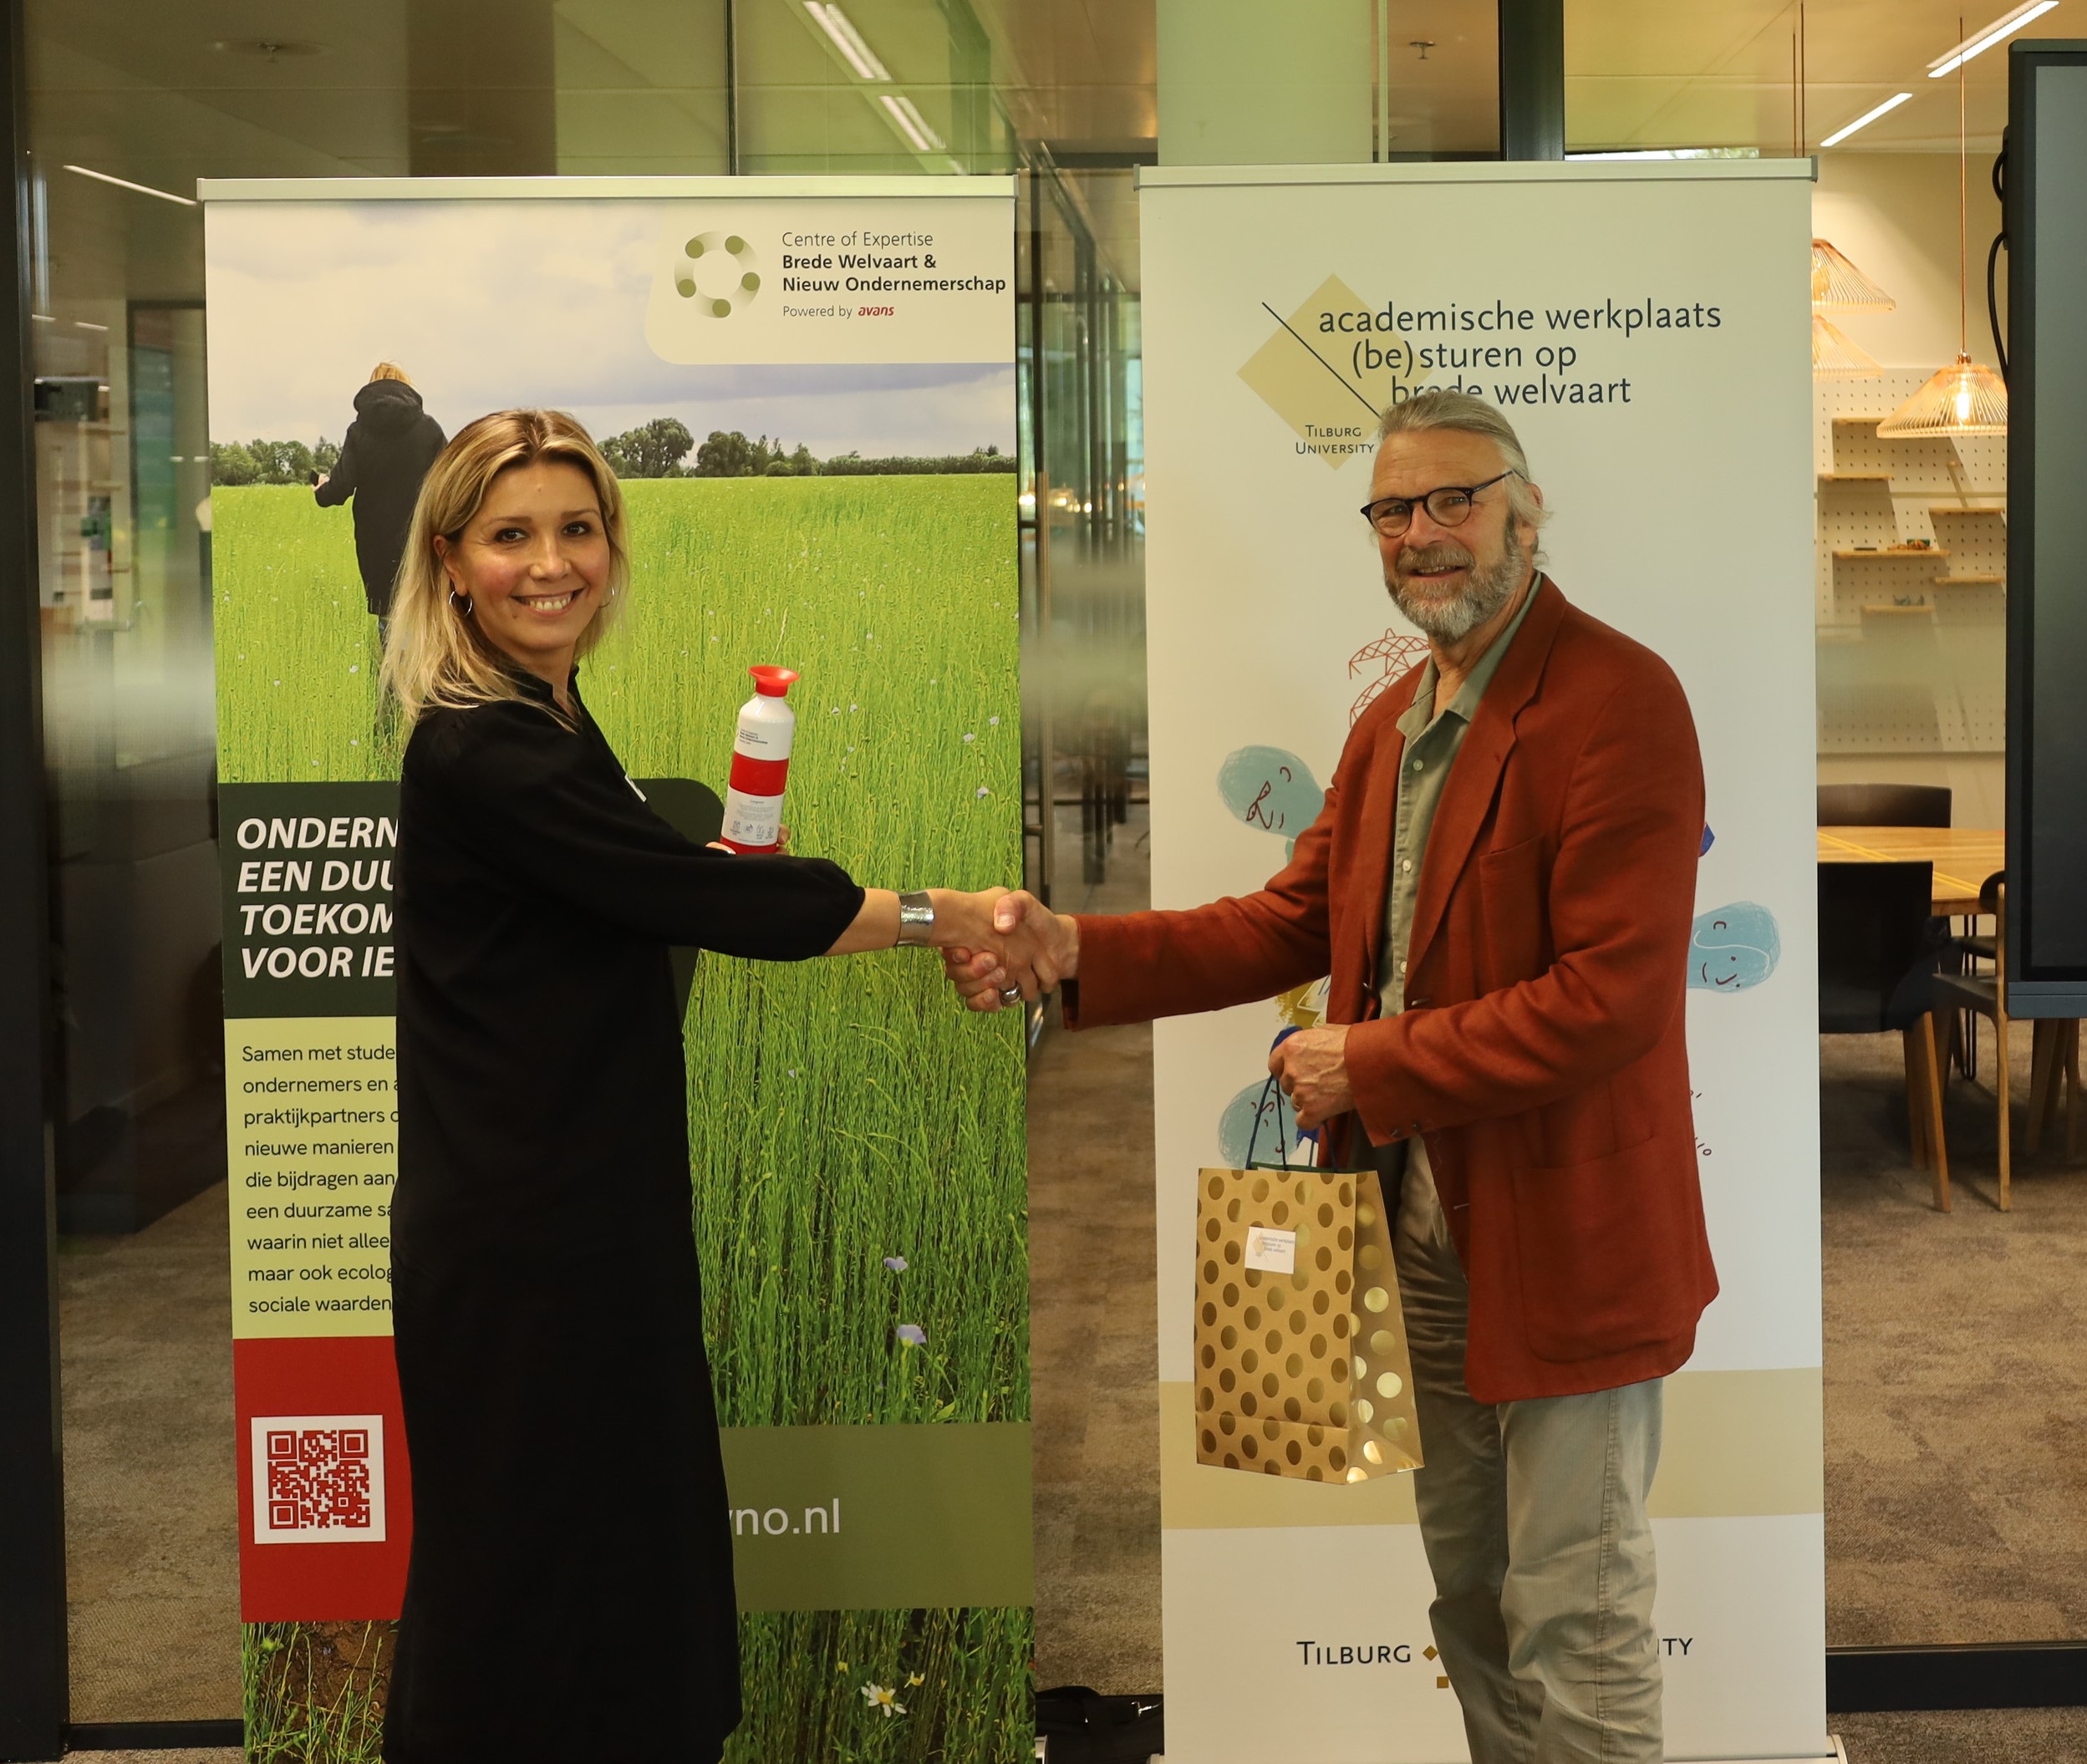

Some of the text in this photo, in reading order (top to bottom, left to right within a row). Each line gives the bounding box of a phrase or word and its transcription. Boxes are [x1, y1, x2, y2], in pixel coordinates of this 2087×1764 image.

[782, 231, 933, 249] Centre of Expertise
[783, 254, 936, 268] Brede Welvaart &
[784, 276, 1005, 293] Nieuw Ondernemerschap
[784, 306, 893, 319] Powered by avans
[1320, 298, 1720, 338] academische werkplaats
[1352, 339, 1576, 379] (be)sturen op
[1494, 374, 1631, 404] welvaart
[1306, 425, 1361, 437] TILBURG
[1296, 442, 1374, 454] UNIVERSITY
[237, 817, 398, 850] ONDERN
[237, 862, 313, 892] EEN
[242, 946, 394, 978] VOOR IE
[242, 1045, 395, 1061] Samen met stude
[243, 1077, 362, 1093] ondernemers
[368, 1080, 388, 1090] en
[245, 1108, 384, 1128] praktijkpartners
[246, 1139, 393, 1156] nieuwe manieren
[246, 1171, 395, 1191] die bijdragen aan
[247, 1207, 278, 1218] een
[284, 1202, 372, 1218] duurzame
[247, 1233, 390, 1249] waarin niet allee
[249, 1269, 294, 1281] maar
[300, 1265, 333, 1280] ook
[250, 1295, 392, 1312] sociale waarden
[729, 1498, 839, 1535] no.nl
[1296, 1641, 1410, 1665] TILBURG
